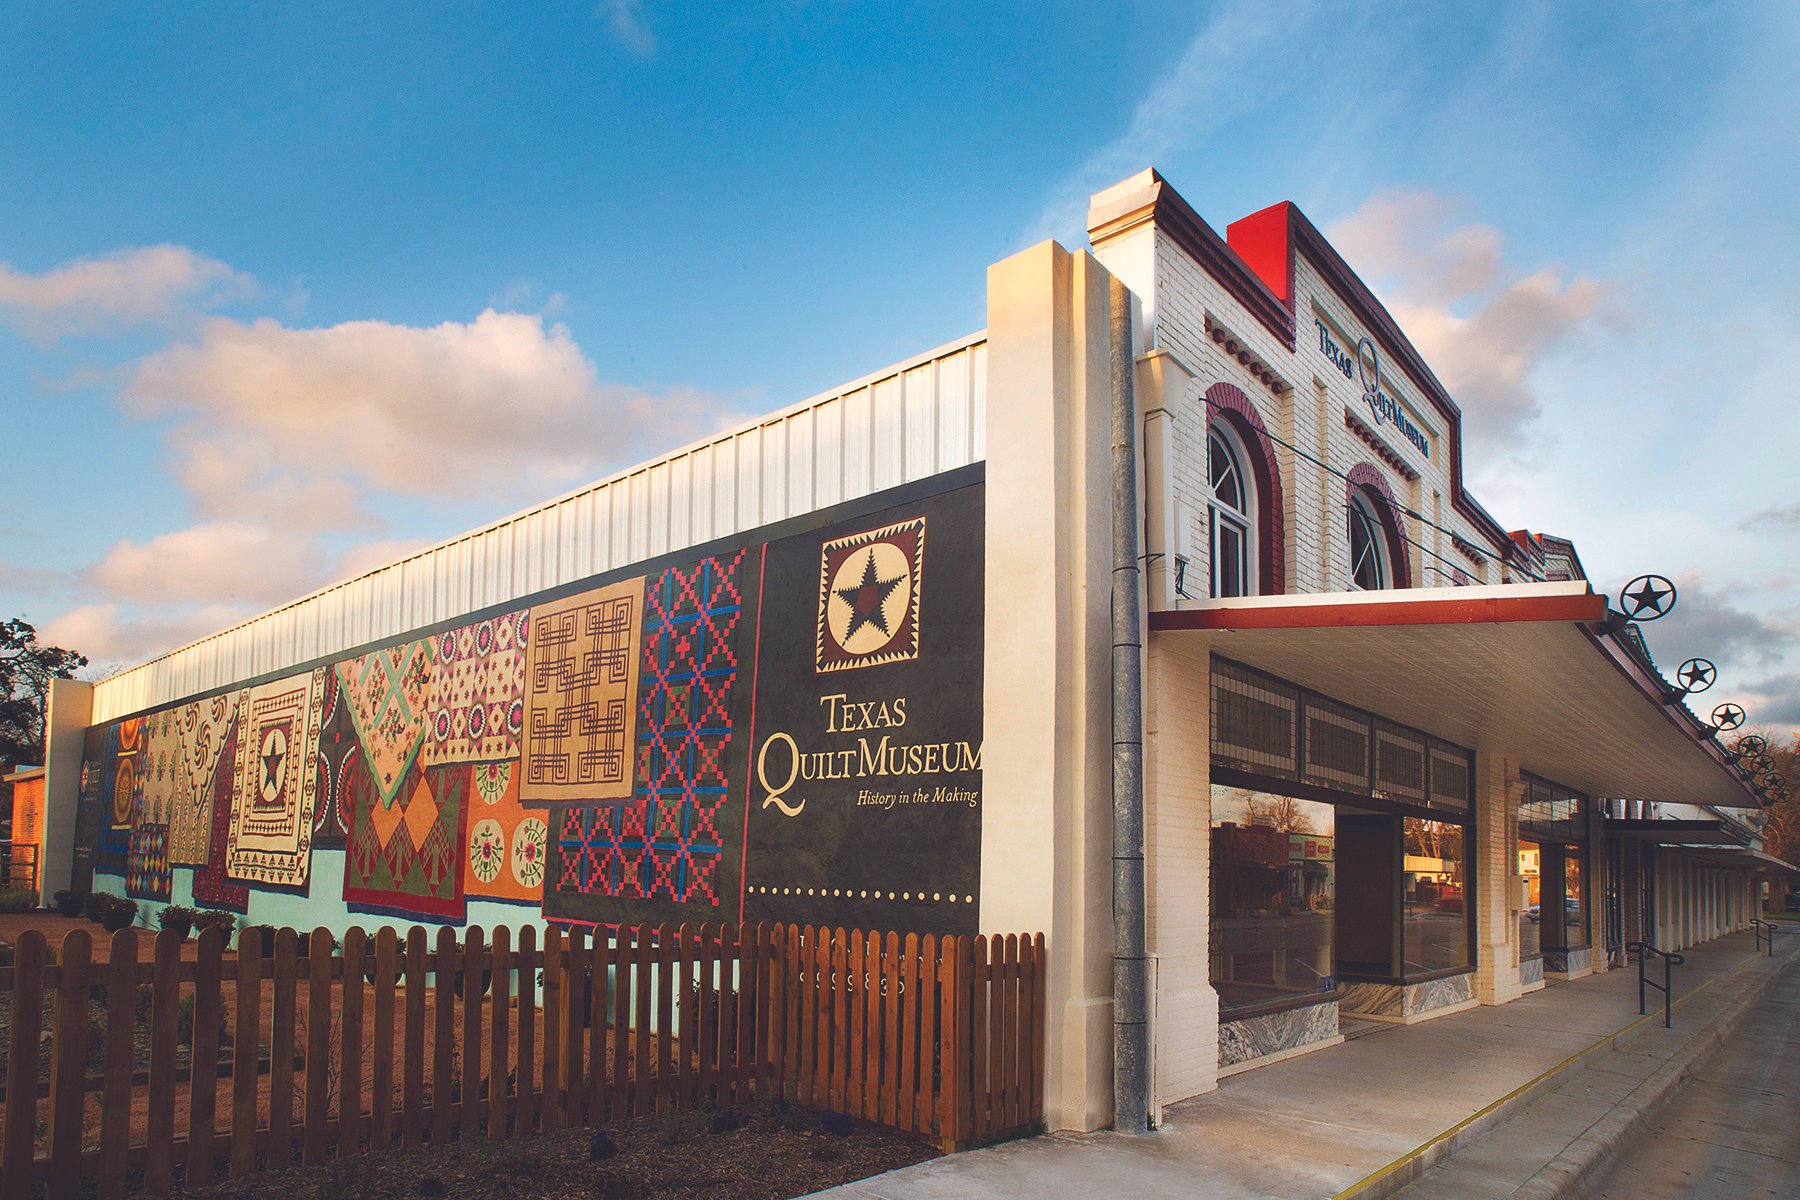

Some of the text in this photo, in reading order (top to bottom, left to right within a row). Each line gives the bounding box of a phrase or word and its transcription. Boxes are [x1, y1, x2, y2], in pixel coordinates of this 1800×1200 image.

[1315, 319, 1352, 379] TEXAS
[1391, 398, 1429, 458] MUSEUM
[757, 693, 983, 817] TEXAS QUILT MUSEUM
[857, 786, 979, 809] History in the Making
